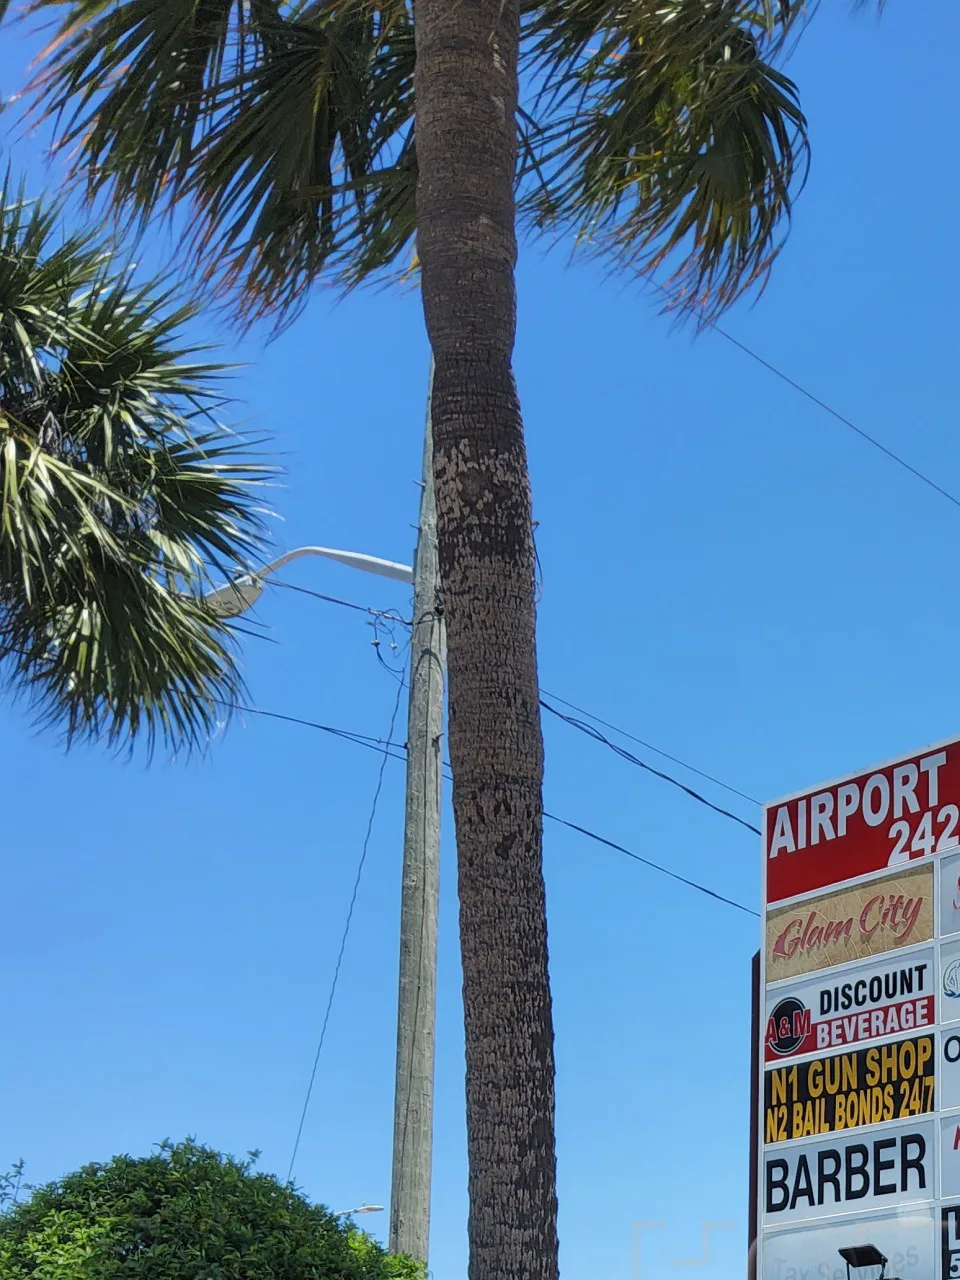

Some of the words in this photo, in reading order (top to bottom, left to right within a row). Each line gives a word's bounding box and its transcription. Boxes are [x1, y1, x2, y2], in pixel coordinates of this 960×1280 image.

[769, 751, 947, 859] AIRPORT
[773, 911, 853, 957] Glam
[859, 894, 924, 944] City
[816, 999, 929, 1049] BEVERAGE
[819, 963, 928, 1016] DISCOUNT
[771, 1065, 798, 1106] N1
[807, 1052, 858, 1098] GUN
[865, 1037, 932, 1087] SHOP
[766, 1104, 788, 1144] N2
[792, 1097, 830, 1139] BAIL
[835, 1083, 895, 1131] BONDS
[899, 1075, 934, 1119] 24/7
[766, 1133, 927, 1214] BARBER
